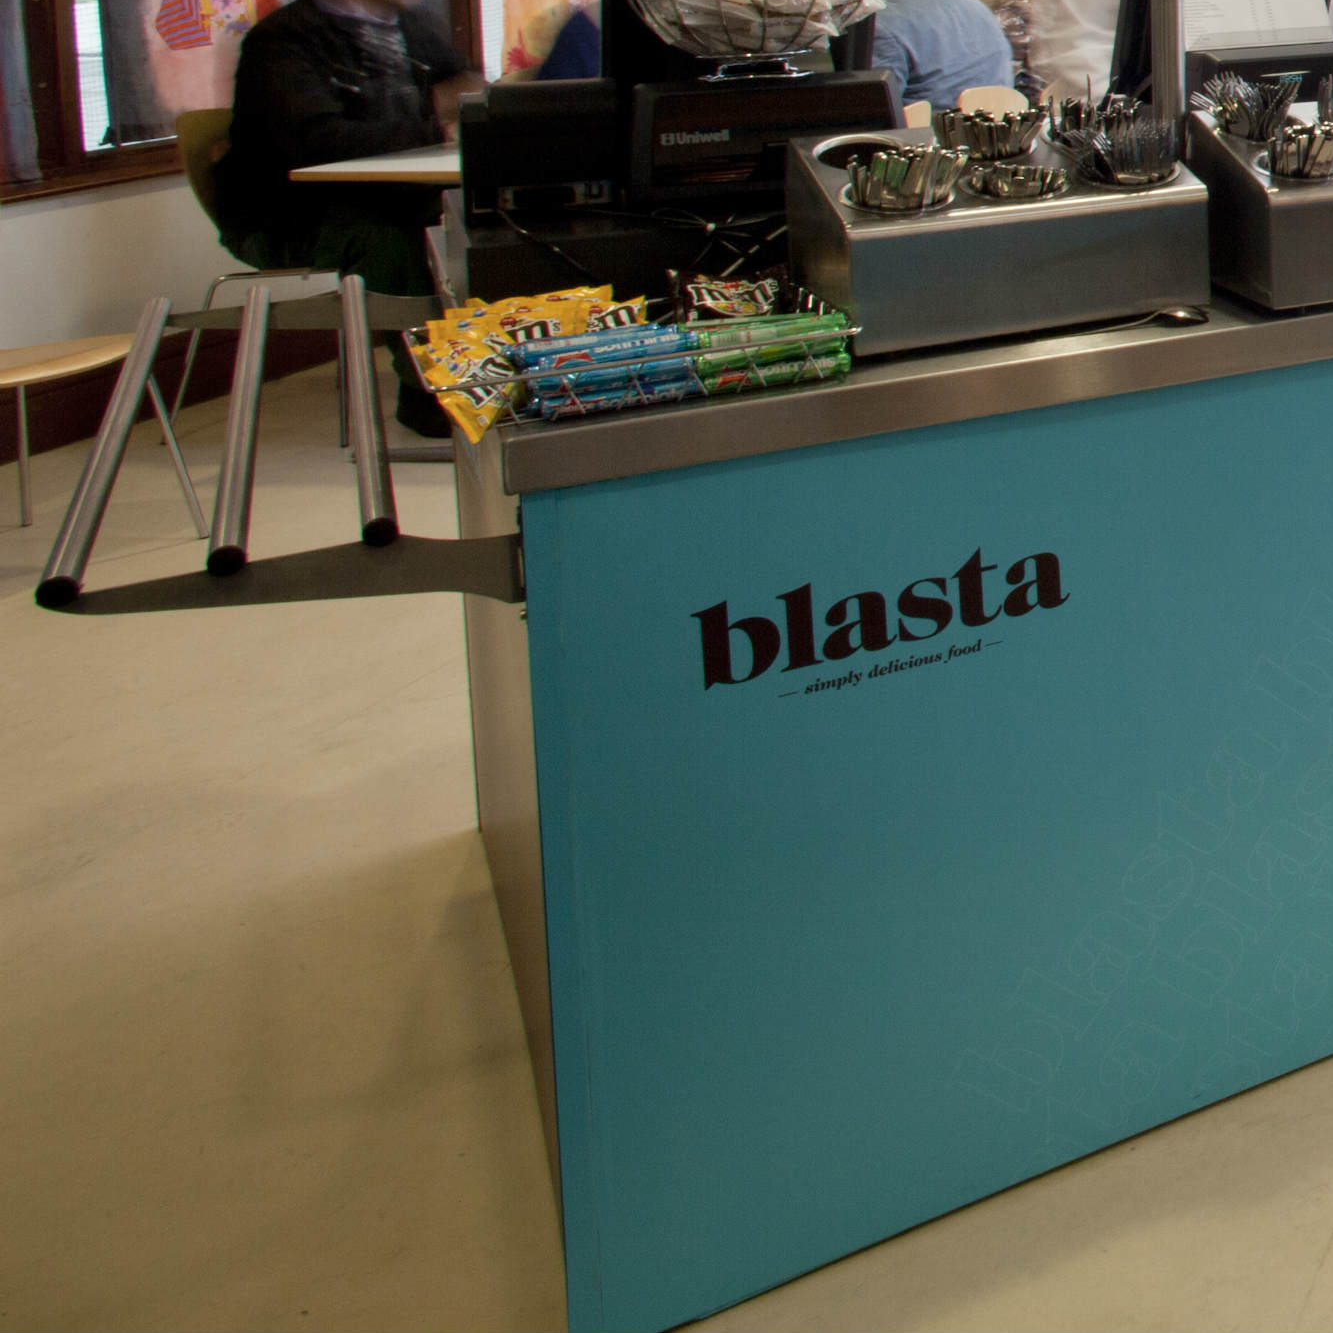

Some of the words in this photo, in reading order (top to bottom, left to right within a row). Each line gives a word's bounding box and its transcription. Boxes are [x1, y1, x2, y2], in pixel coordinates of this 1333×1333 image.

[676, 129, 729, 145] Uniwell
[690, 546, 1071, 690] blasta
[804, 669, 863, 695] simply
[868, 652, 942, 679] delicious
[943, 639, 982, 664] food
